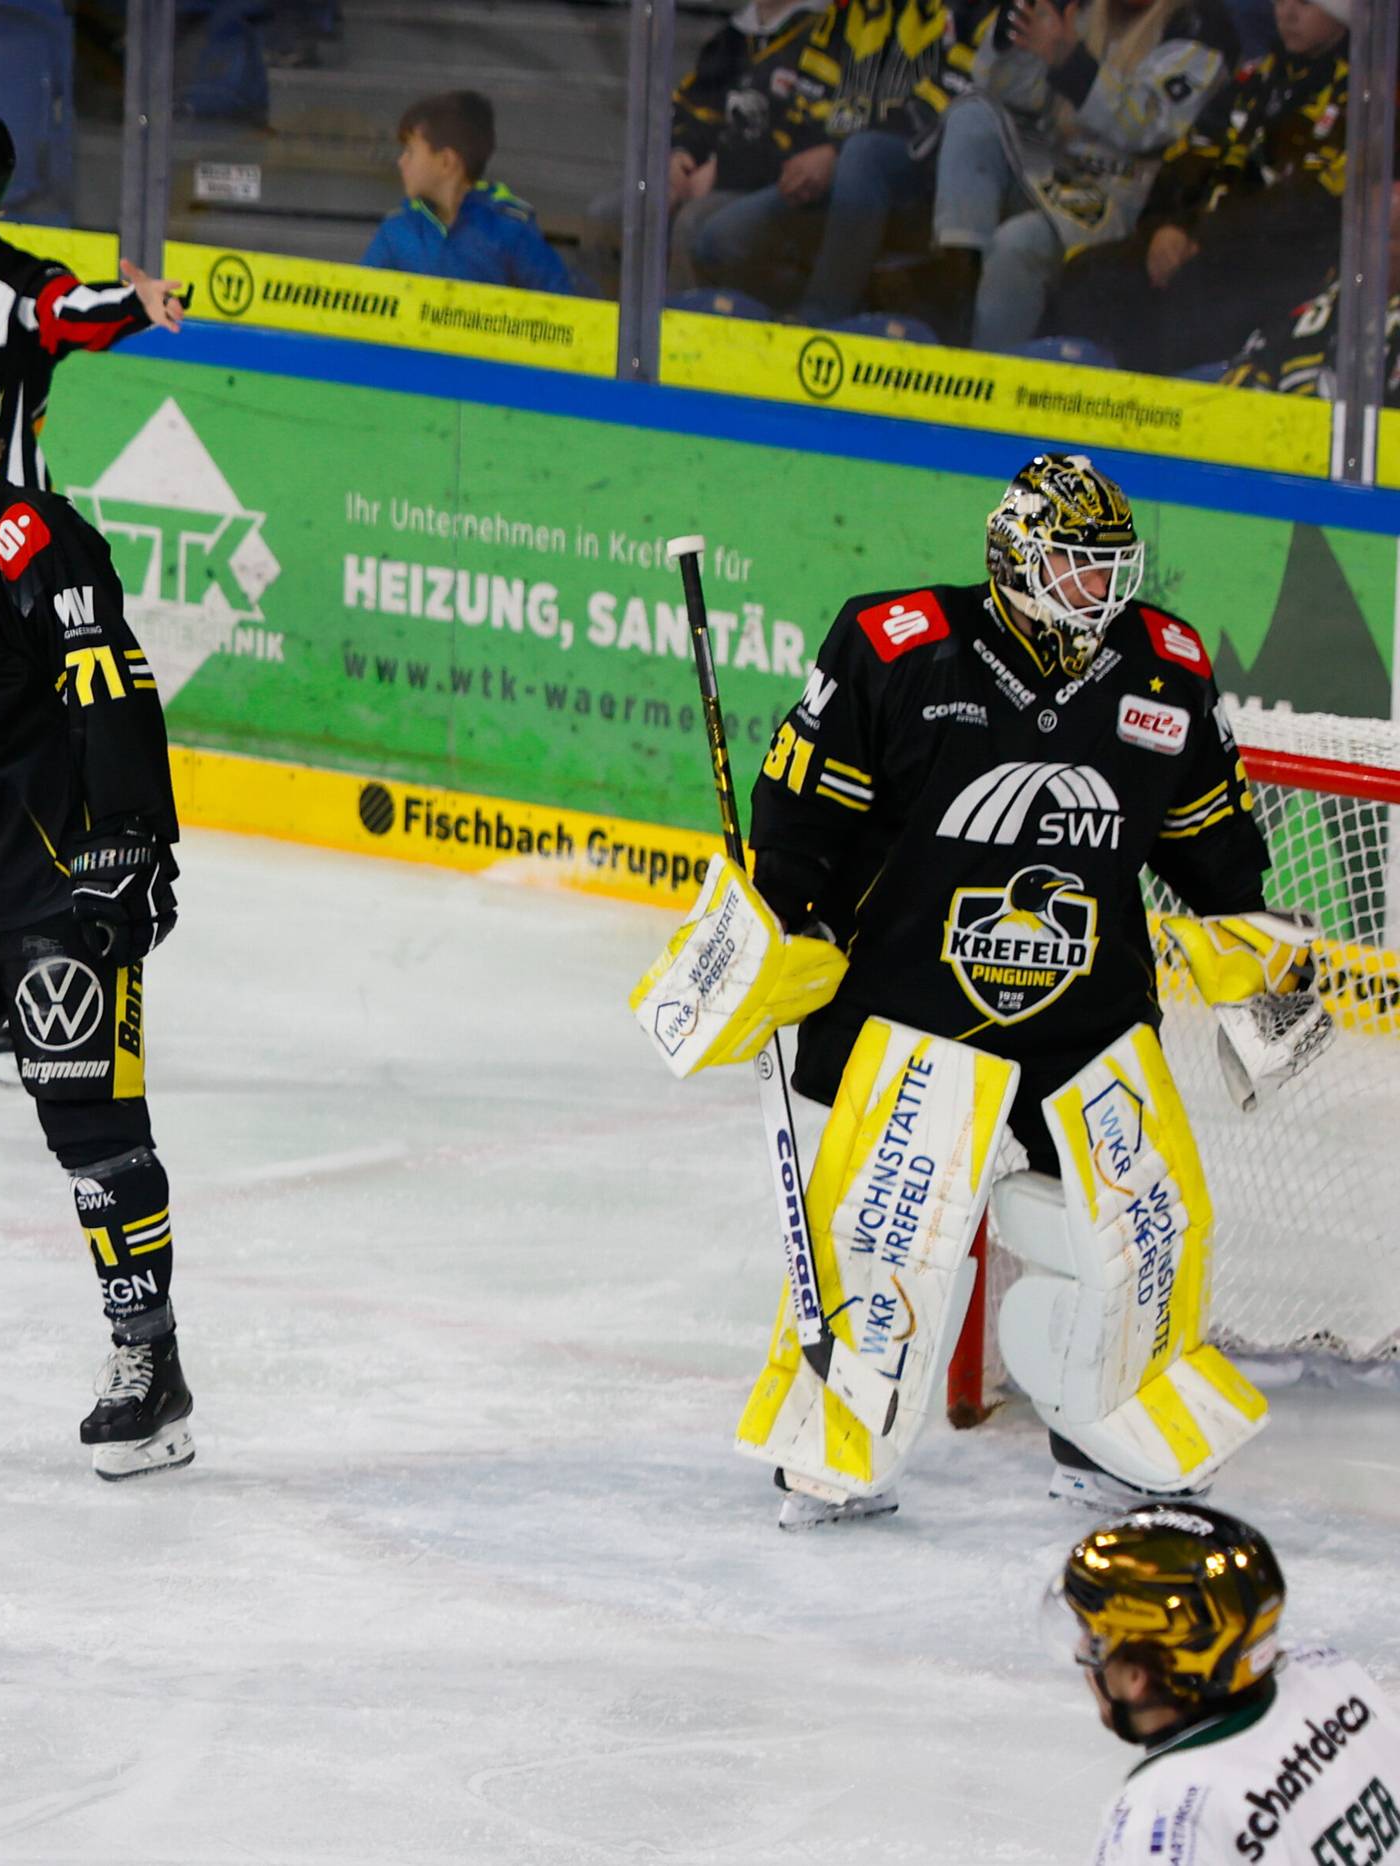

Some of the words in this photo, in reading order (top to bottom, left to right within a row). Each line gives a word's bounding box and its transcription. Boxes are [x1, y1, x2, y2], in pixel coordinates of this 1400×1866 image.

[262, 278, 401, 319] WARRIOR
[851, 361, 996, 403] WARRIOR
[344, 491, 380, 525] Ihr
[390, 498, 567, 554] Unternehmen
[575, 525, 600, 560] in
[608, 530, 703, 574] Krefe
[714, 545, 753, 583] für
[342, 553, 575, 651] HEIZUNG,
[65, 644, 127, 708] 71
[762, 720, 816, 797] 31
[402, 794, 576, 860] Fischbach
[586, 826, 710, 891] Gruppe
[697, 937, 737, 1001] KREFELD
[950, 930, 1089, 968] KREFELD
[970, 963, 1058, 988] PINGUINE
[21, 1057, 111, 1085] Borgmann
[1097, 1105, 1134, 1179] WKR
[76, 1189, 118, 1212] SWK
[880, 1153, 937, 1269] KREFELD
[859, 1292, 898, 1356] WKR
[1234, 1695, 1372, 1864] schattdeco
